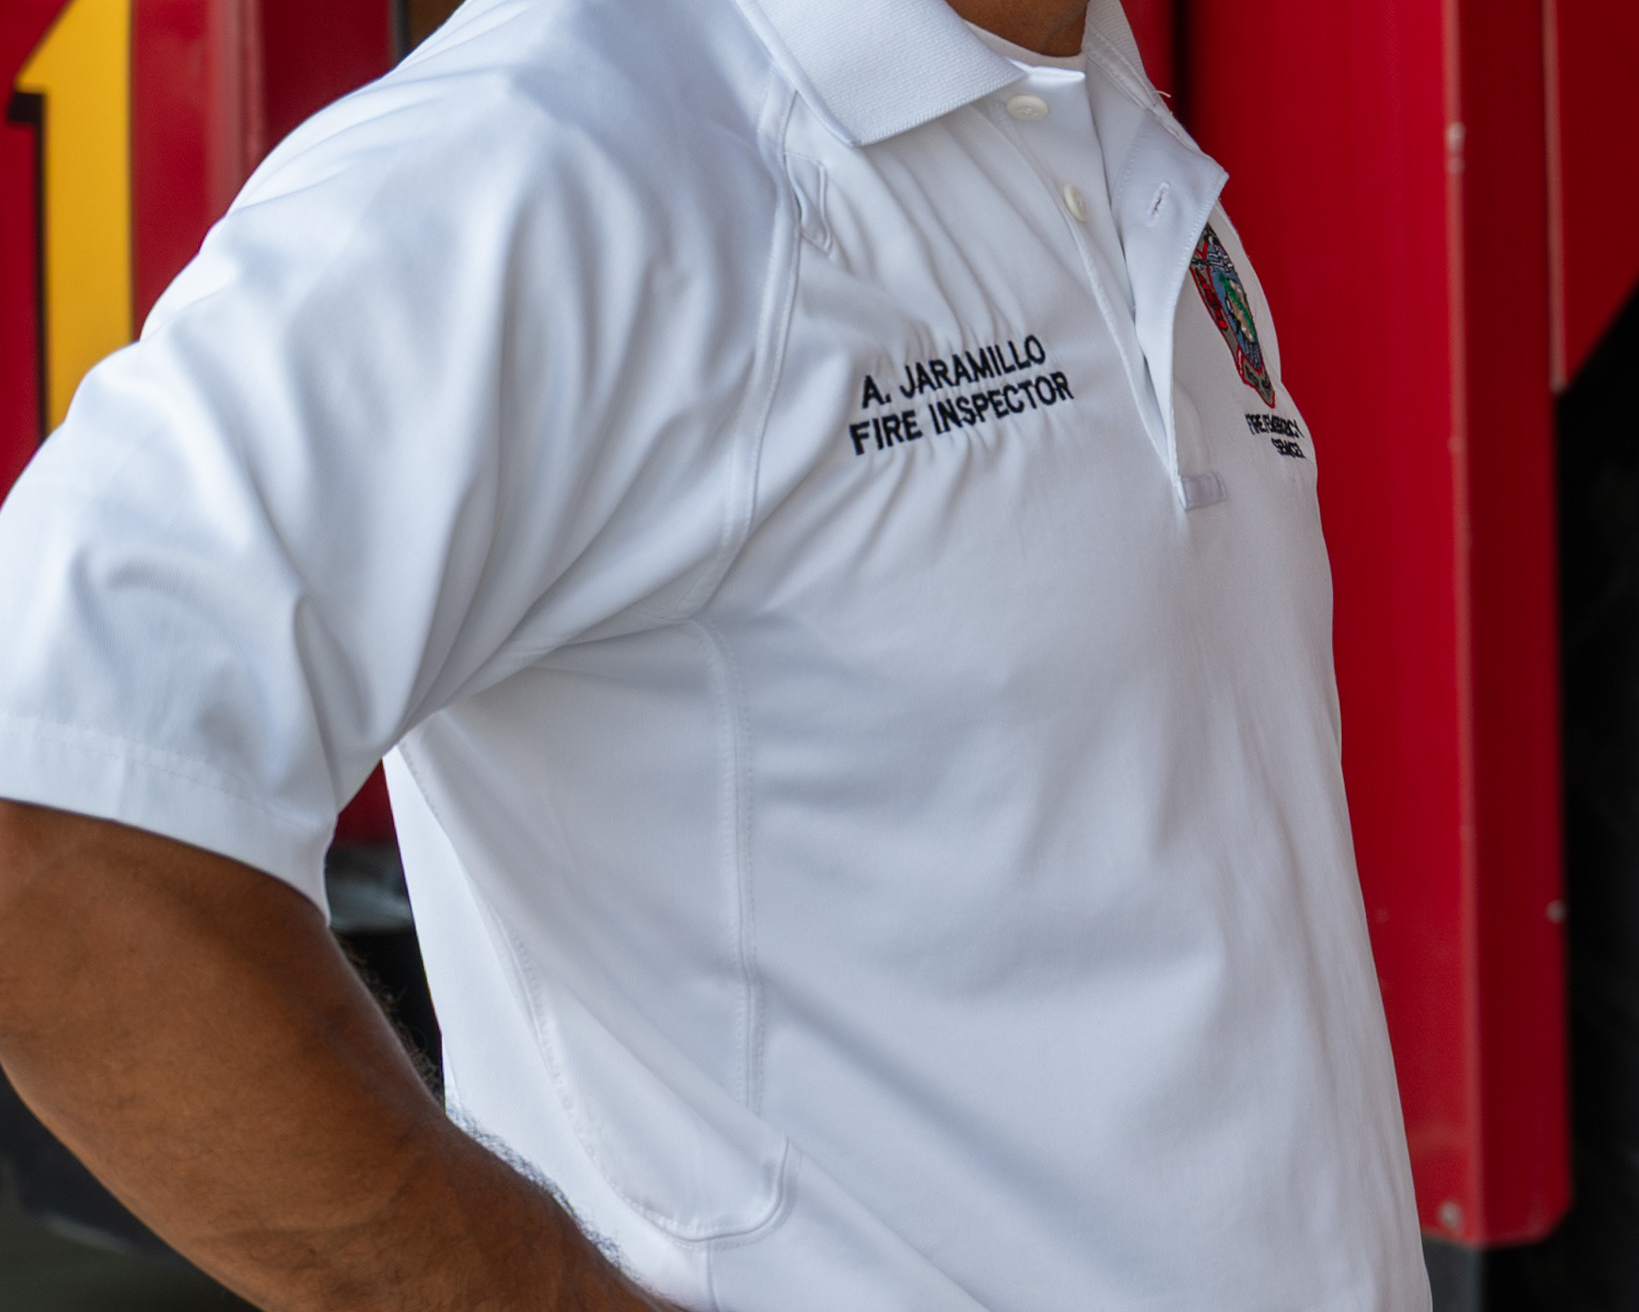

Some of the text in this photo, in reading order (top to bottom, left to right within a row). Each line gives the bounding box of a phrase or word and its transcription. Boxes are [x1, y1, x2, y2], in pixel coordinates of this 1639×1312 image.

[861, 334, 1047, 410] A. JARAMILLO
[849, 370, 1076, 457] FIRE INSPECTOR
